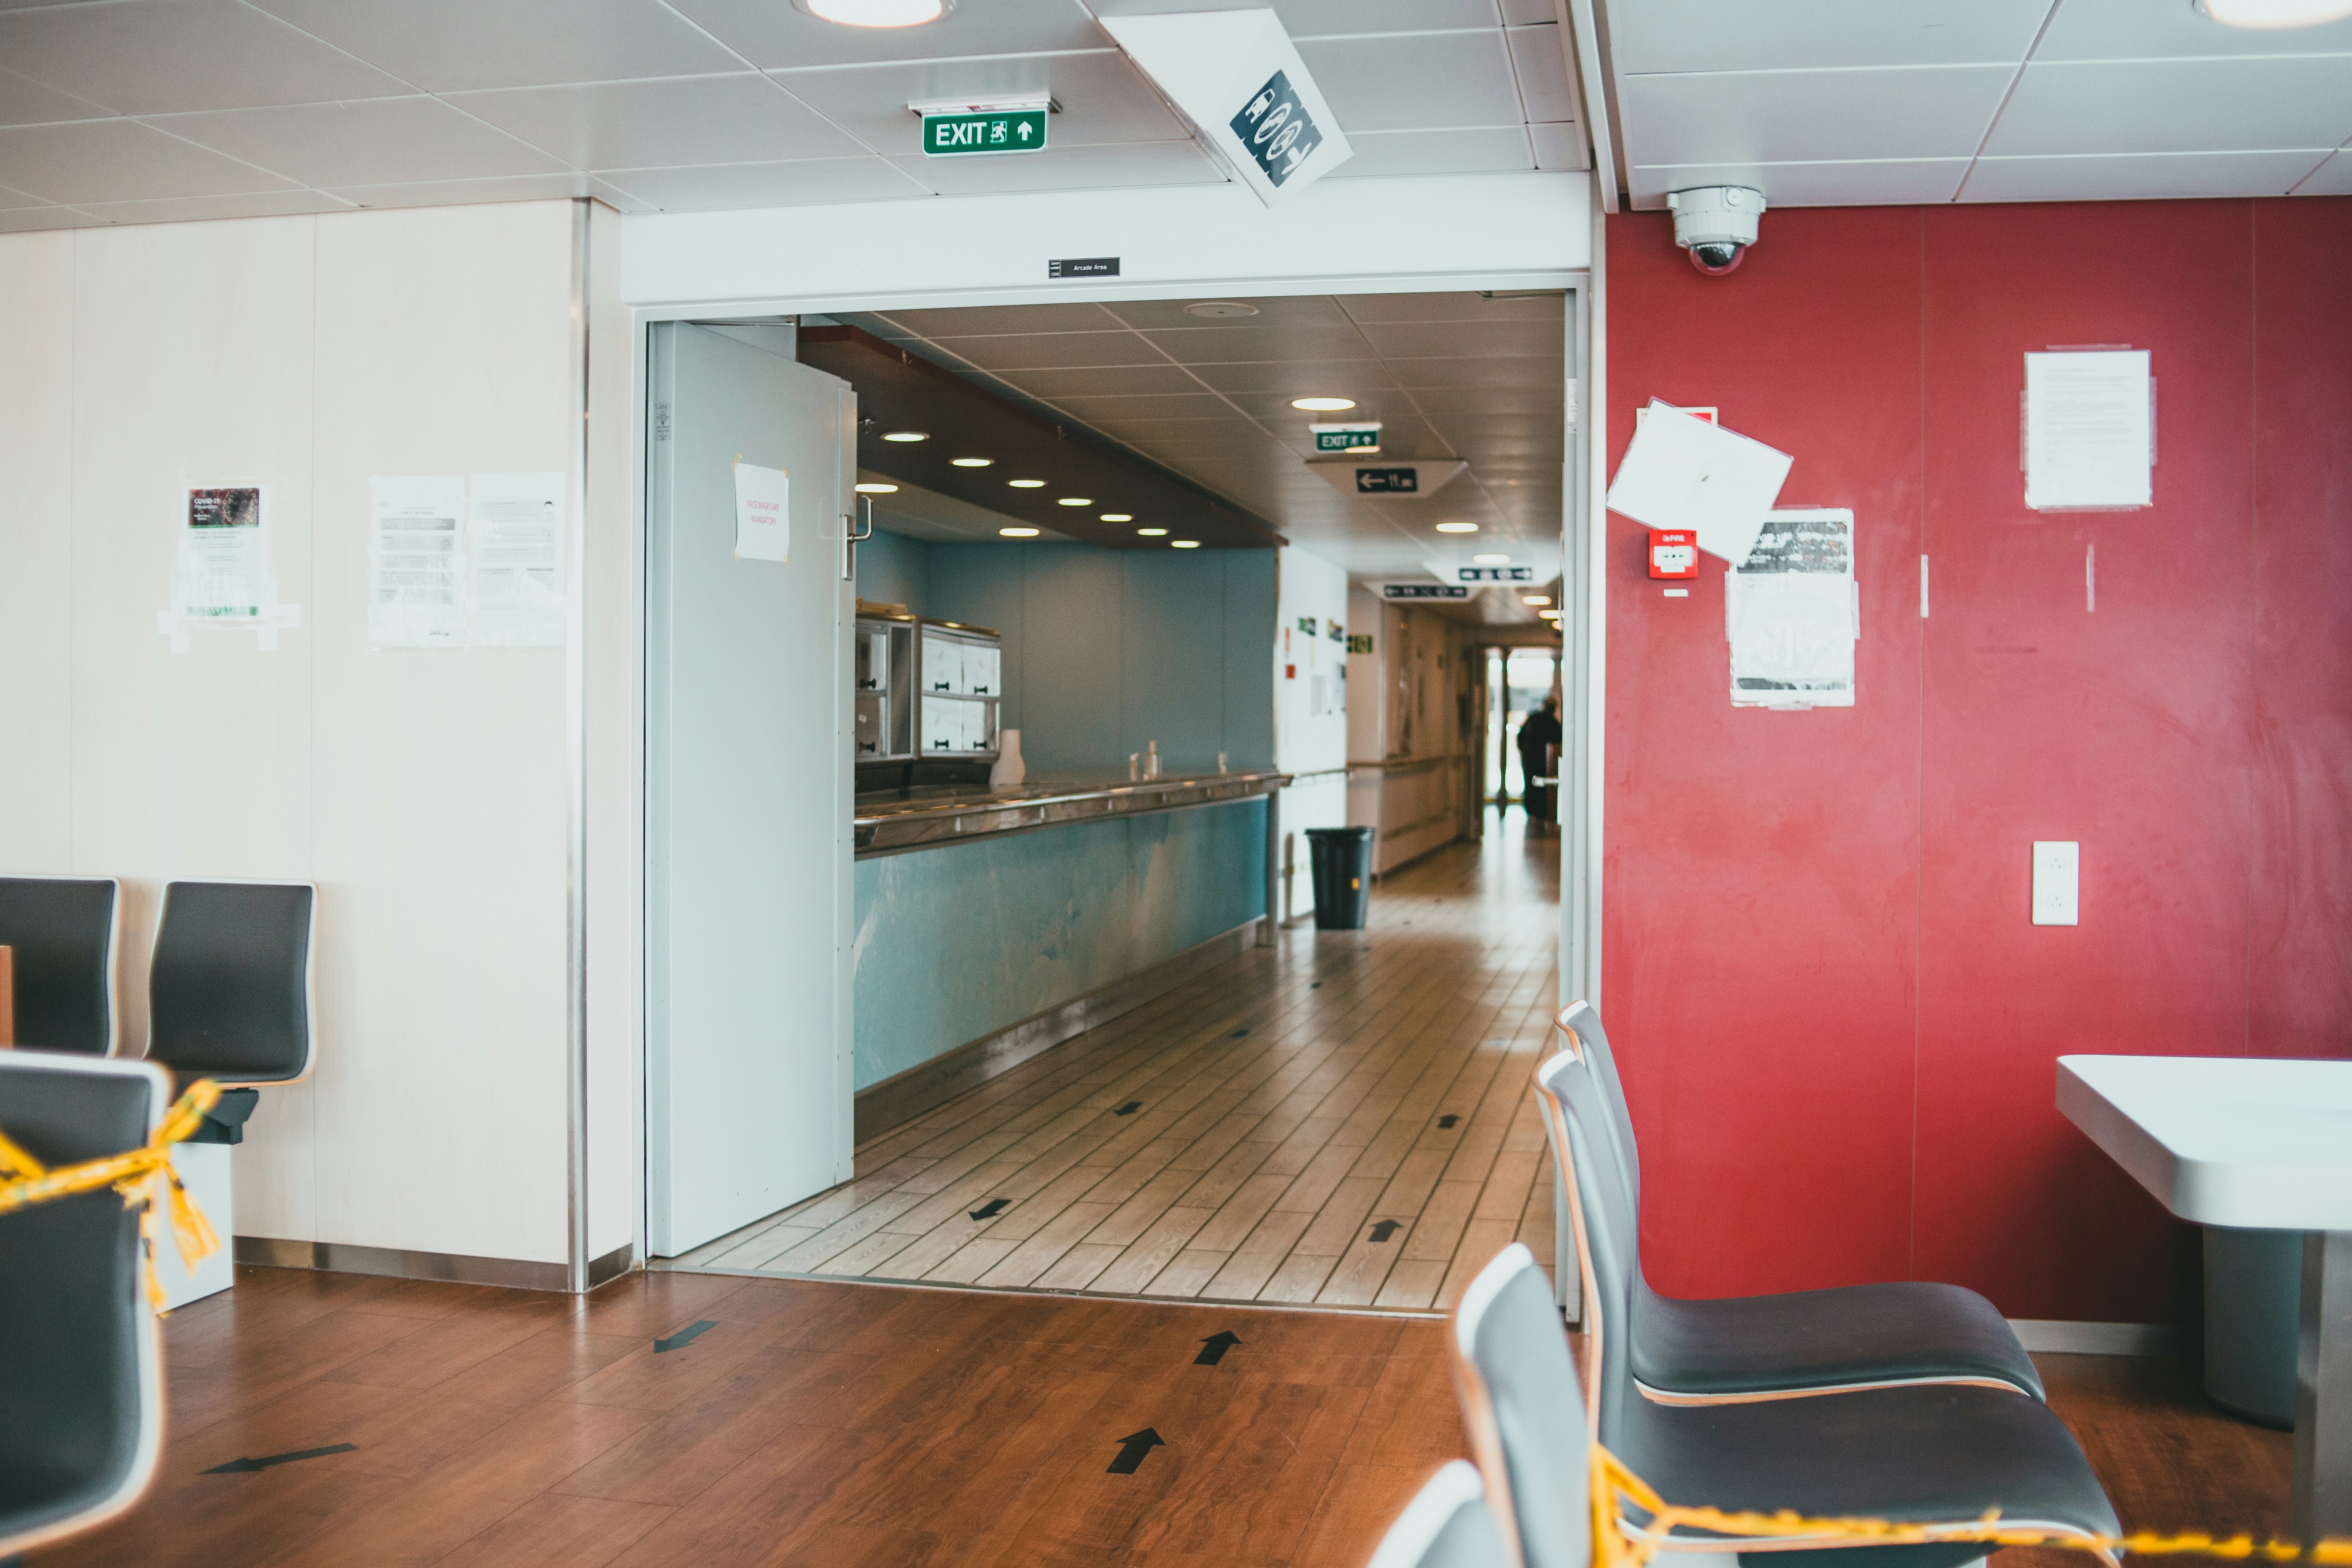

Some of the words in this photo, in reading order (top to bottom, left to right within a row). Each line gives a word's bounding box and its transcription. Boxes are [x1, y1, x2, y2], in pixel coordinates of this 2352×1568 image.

[936, 122, 987, 146] EXIT
[1322, 435, 1348, 447] EXIT
[746, 499, 758, 509] FACE
[758, 501, 771, 511] MASKS
[772, 503, 780, 512] ARE
[751, 515, 777, 525] MANDATORY
